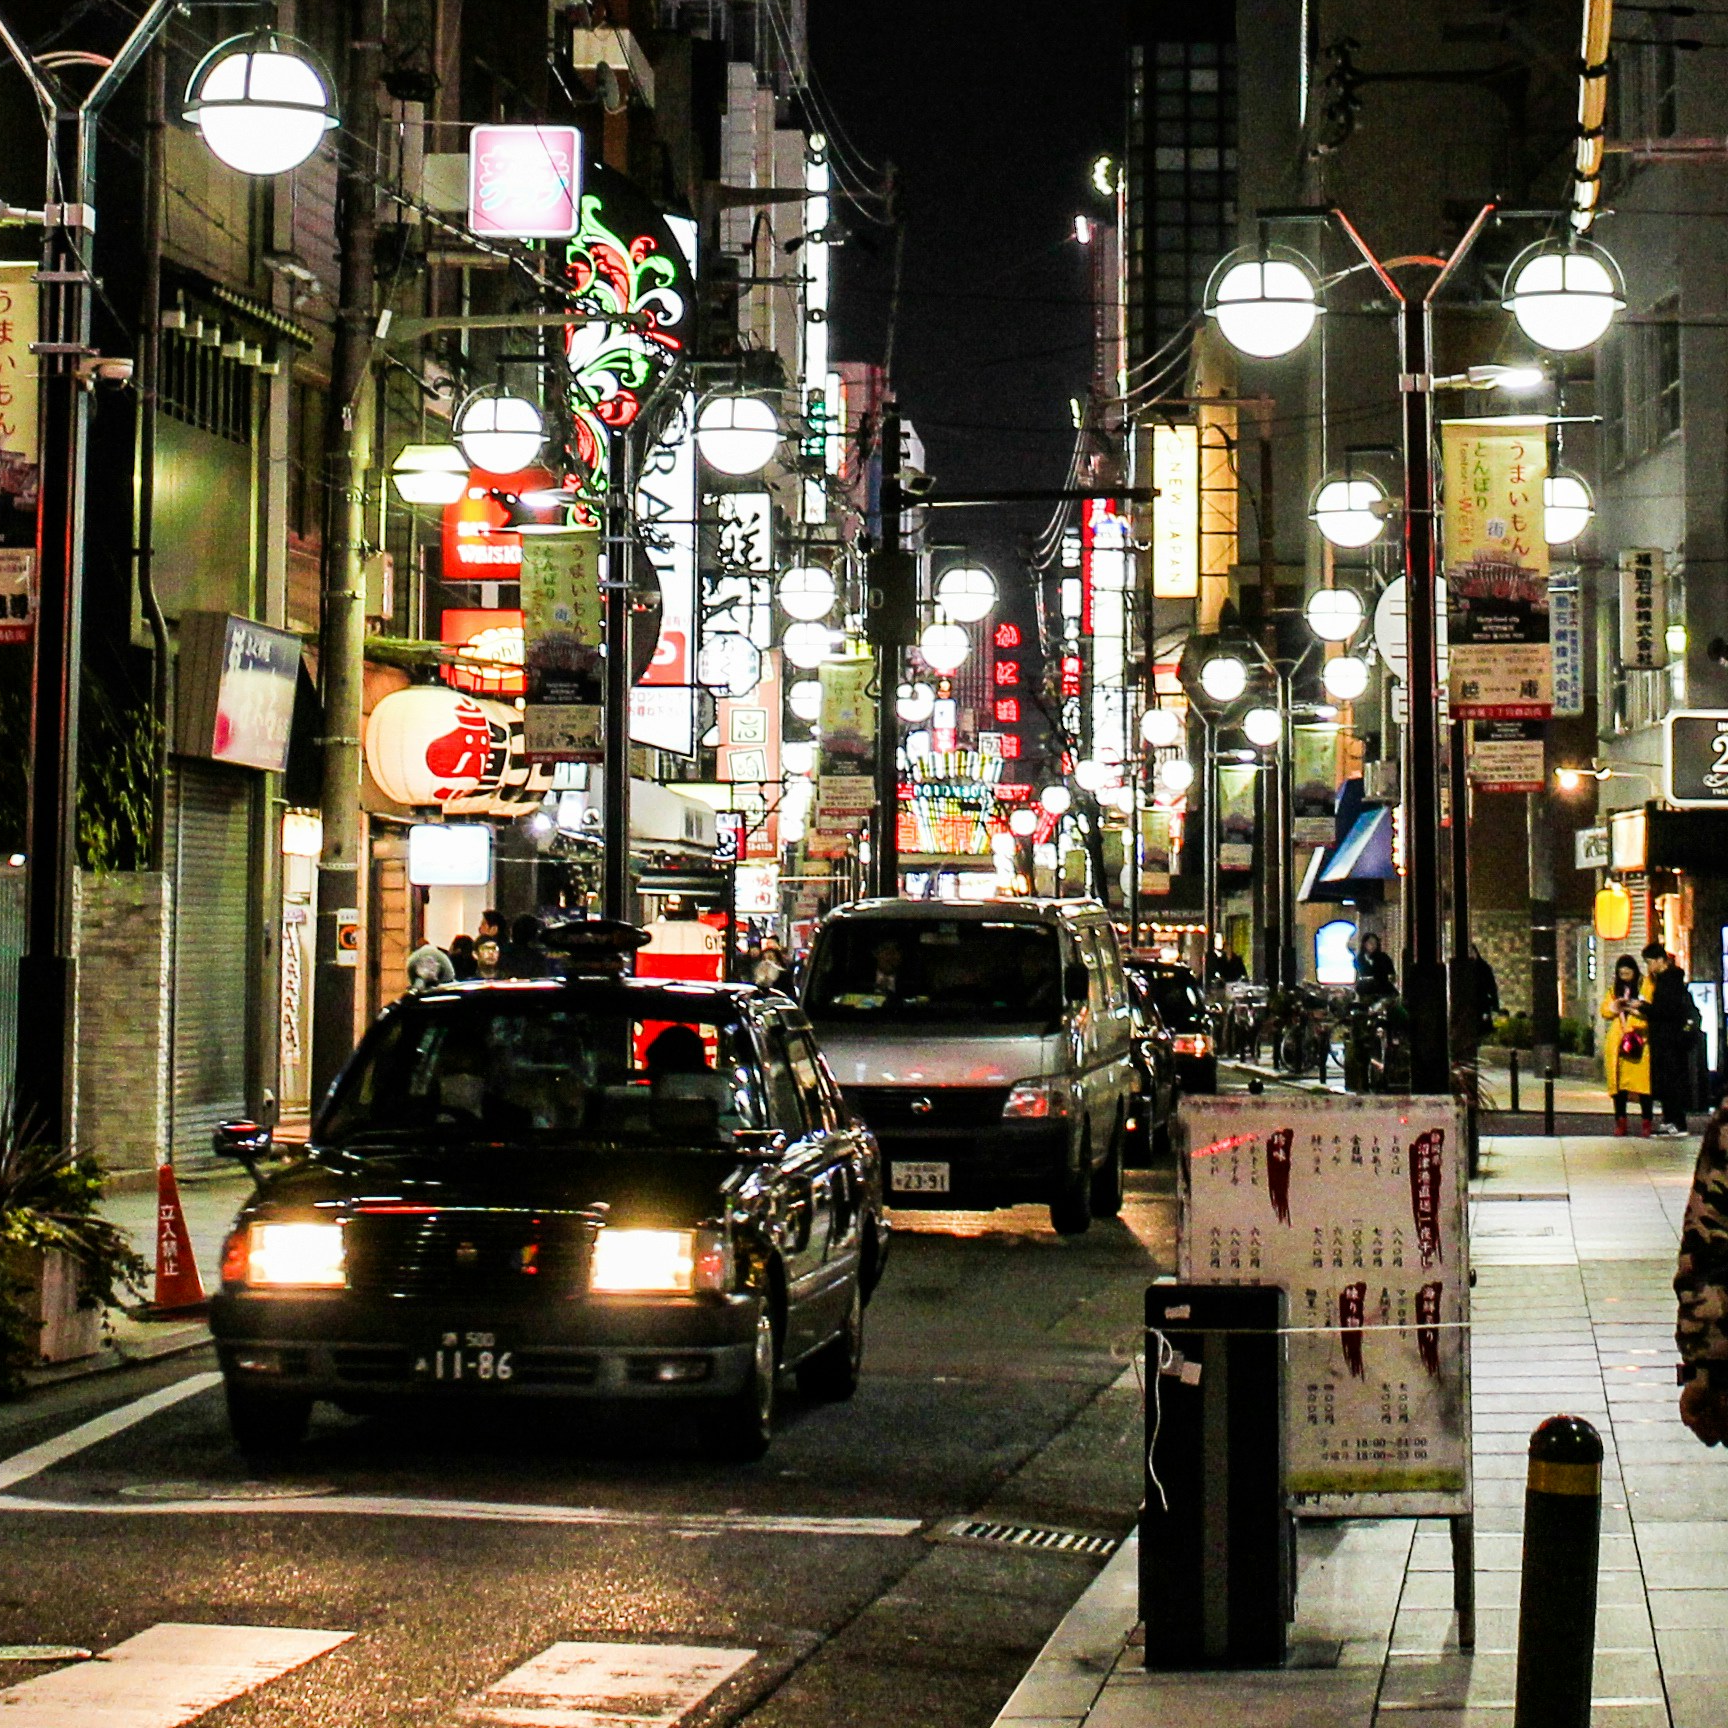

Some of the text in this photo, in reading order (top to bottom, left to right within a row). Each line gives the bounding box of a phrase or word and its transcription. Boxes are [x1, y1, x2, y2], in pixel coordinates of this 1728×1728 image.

[1507, 440, 1531, 558] うまいもん
[903, 1172, 946, 1191] 23-91
[159, 1203, 180, 1276] 立入禁止
[434, 1349, 513, 1380] 11-86
